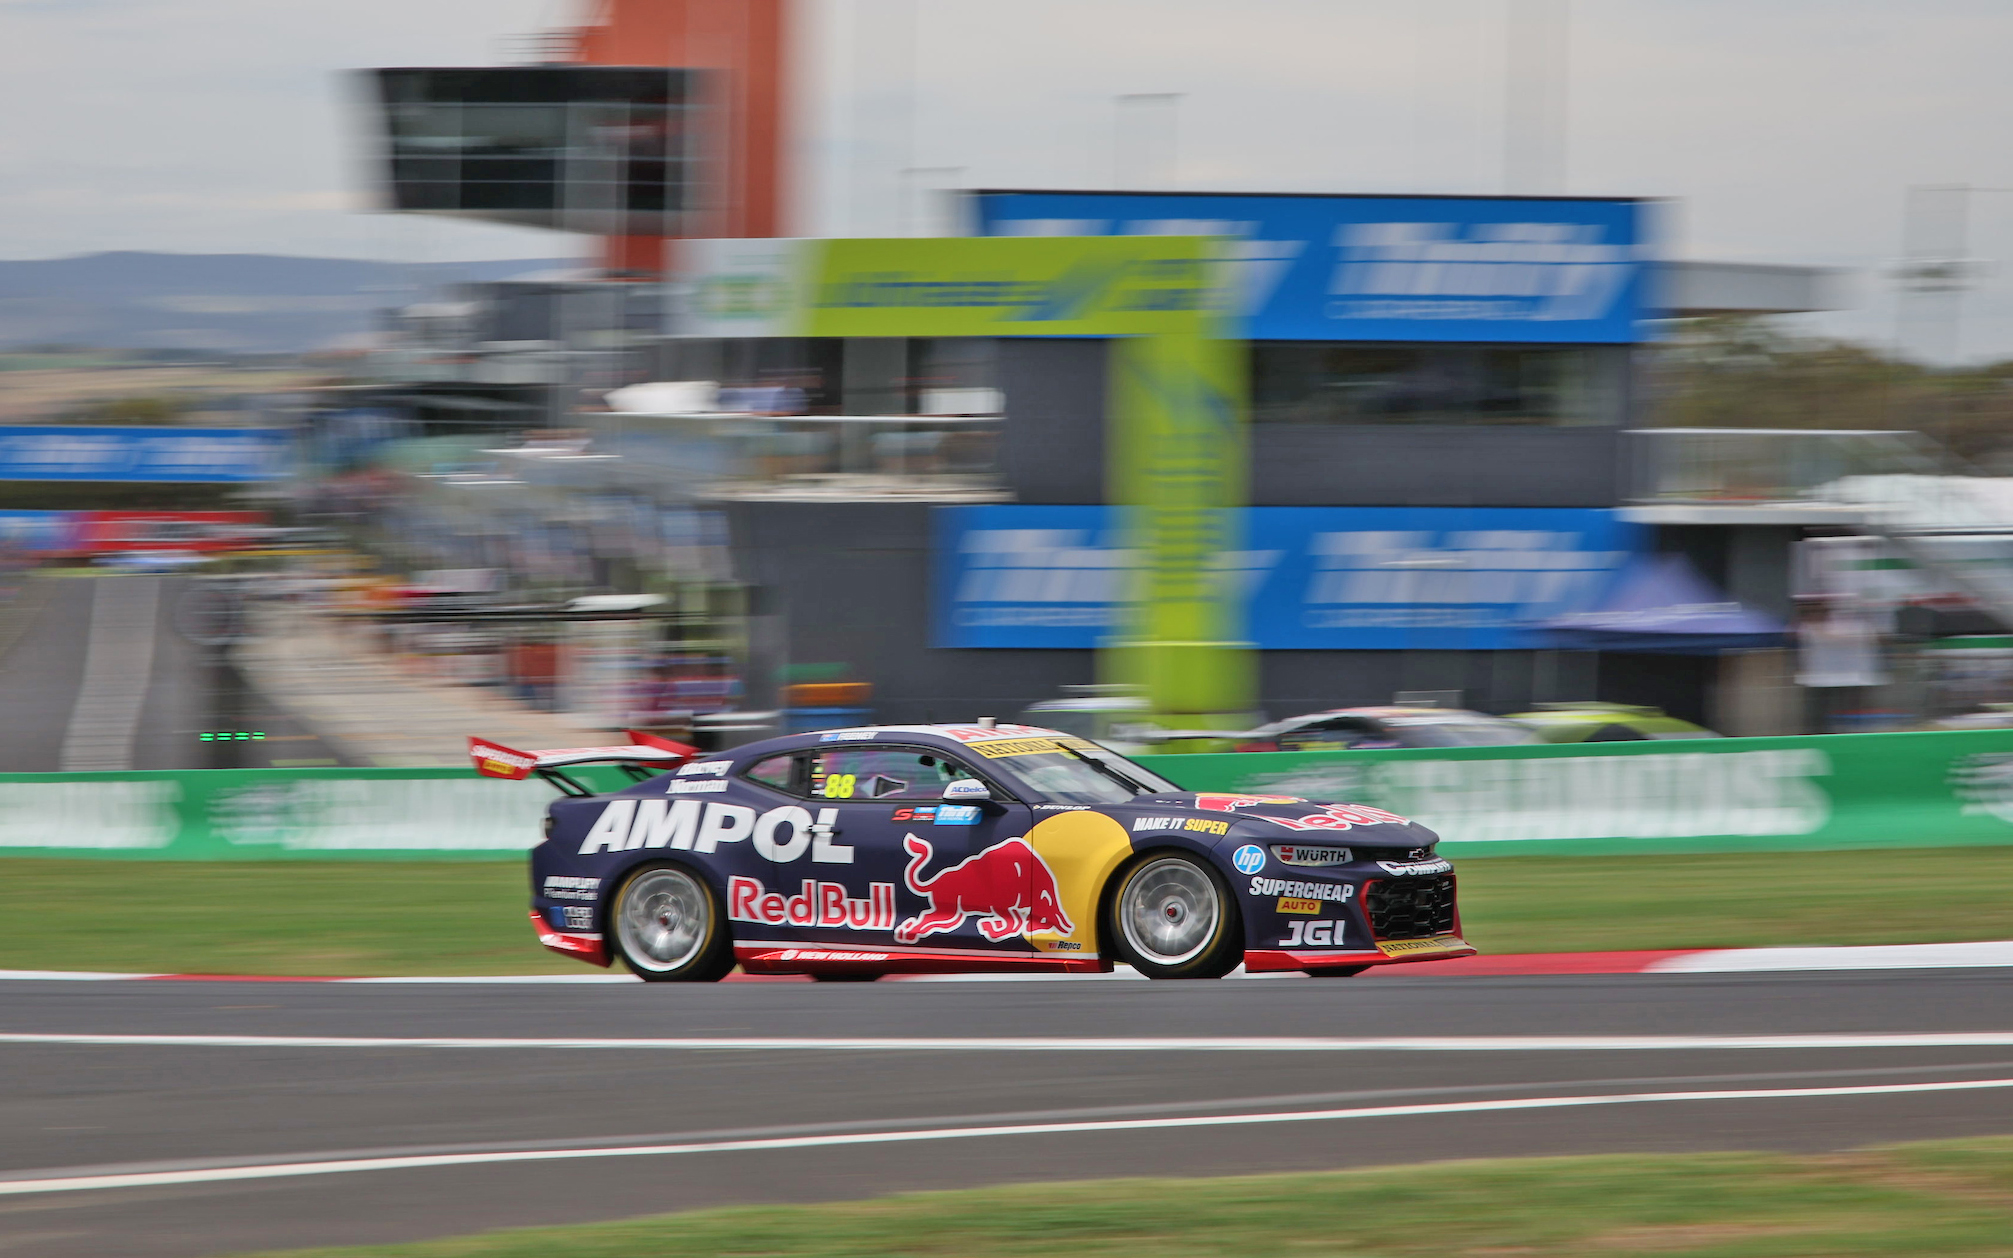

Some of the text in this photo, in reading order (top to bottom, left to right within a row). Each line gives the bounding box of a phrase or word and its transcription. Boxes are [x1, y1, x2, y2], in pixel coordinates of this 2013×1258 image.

[824, 773, 857, 798] 88
[577, 799, 855, 863] AMPOL
[1133, 817, 1229, 836] MAKE IT SUPER
[1237, 851, 1262, 872] hp
[1248, 876, 1354, 903] SUPERCHEAP
[1281, 902, 1317, 911] AUTO
[1278, 920, 1345, 947] JGI
[797, 951, 889, 961] NEW HOLLAND
[1057, 941, 1082, 950] Repco
